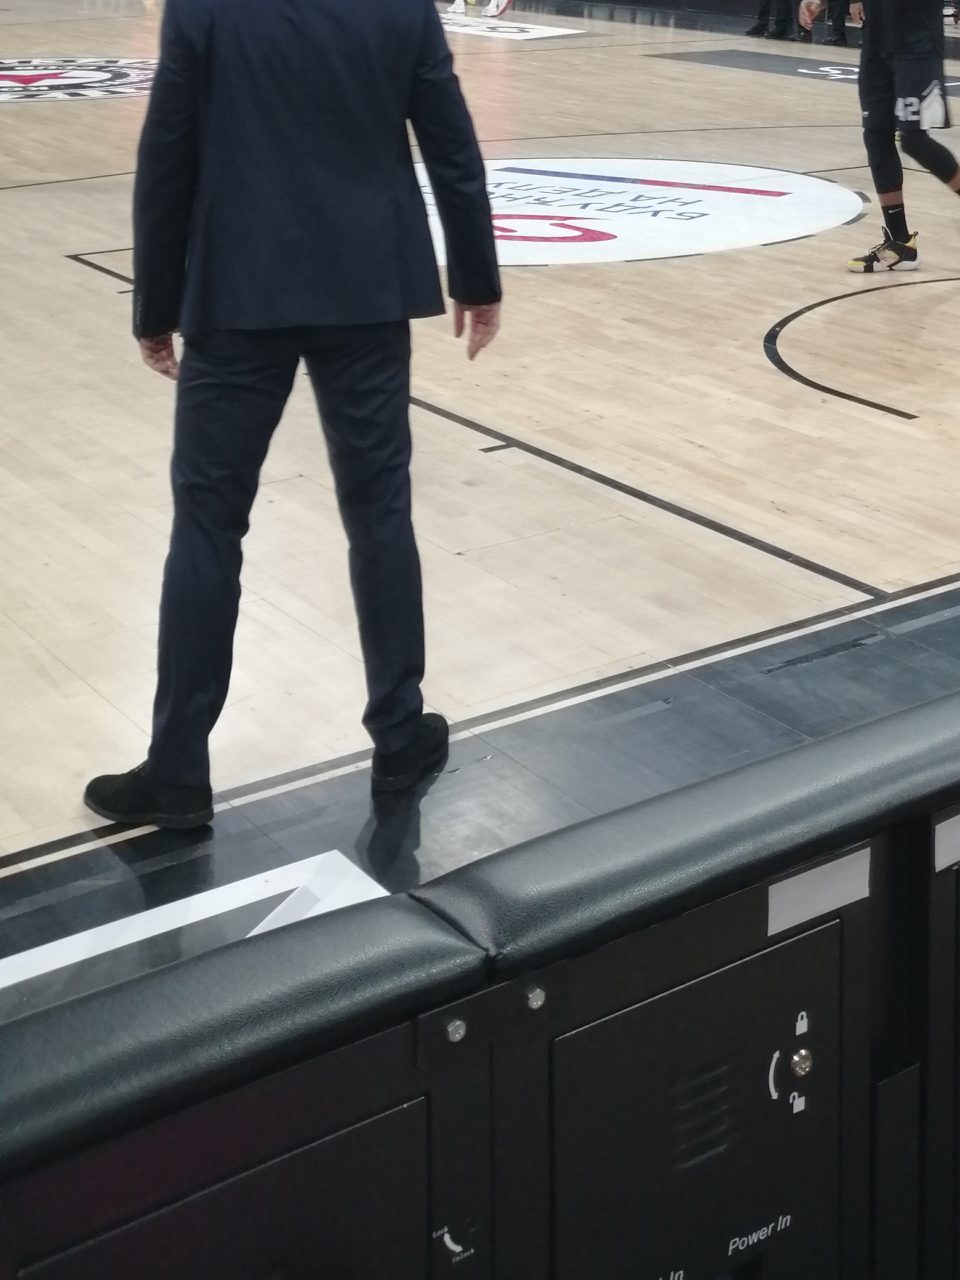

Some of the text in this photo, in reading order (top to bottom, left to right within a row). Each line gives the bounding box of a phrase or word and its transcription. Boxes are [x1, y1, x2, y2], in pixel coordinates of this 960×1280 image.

[895, 96, 921, 122] 42
[728, 1214, 791, 1257] Power In
